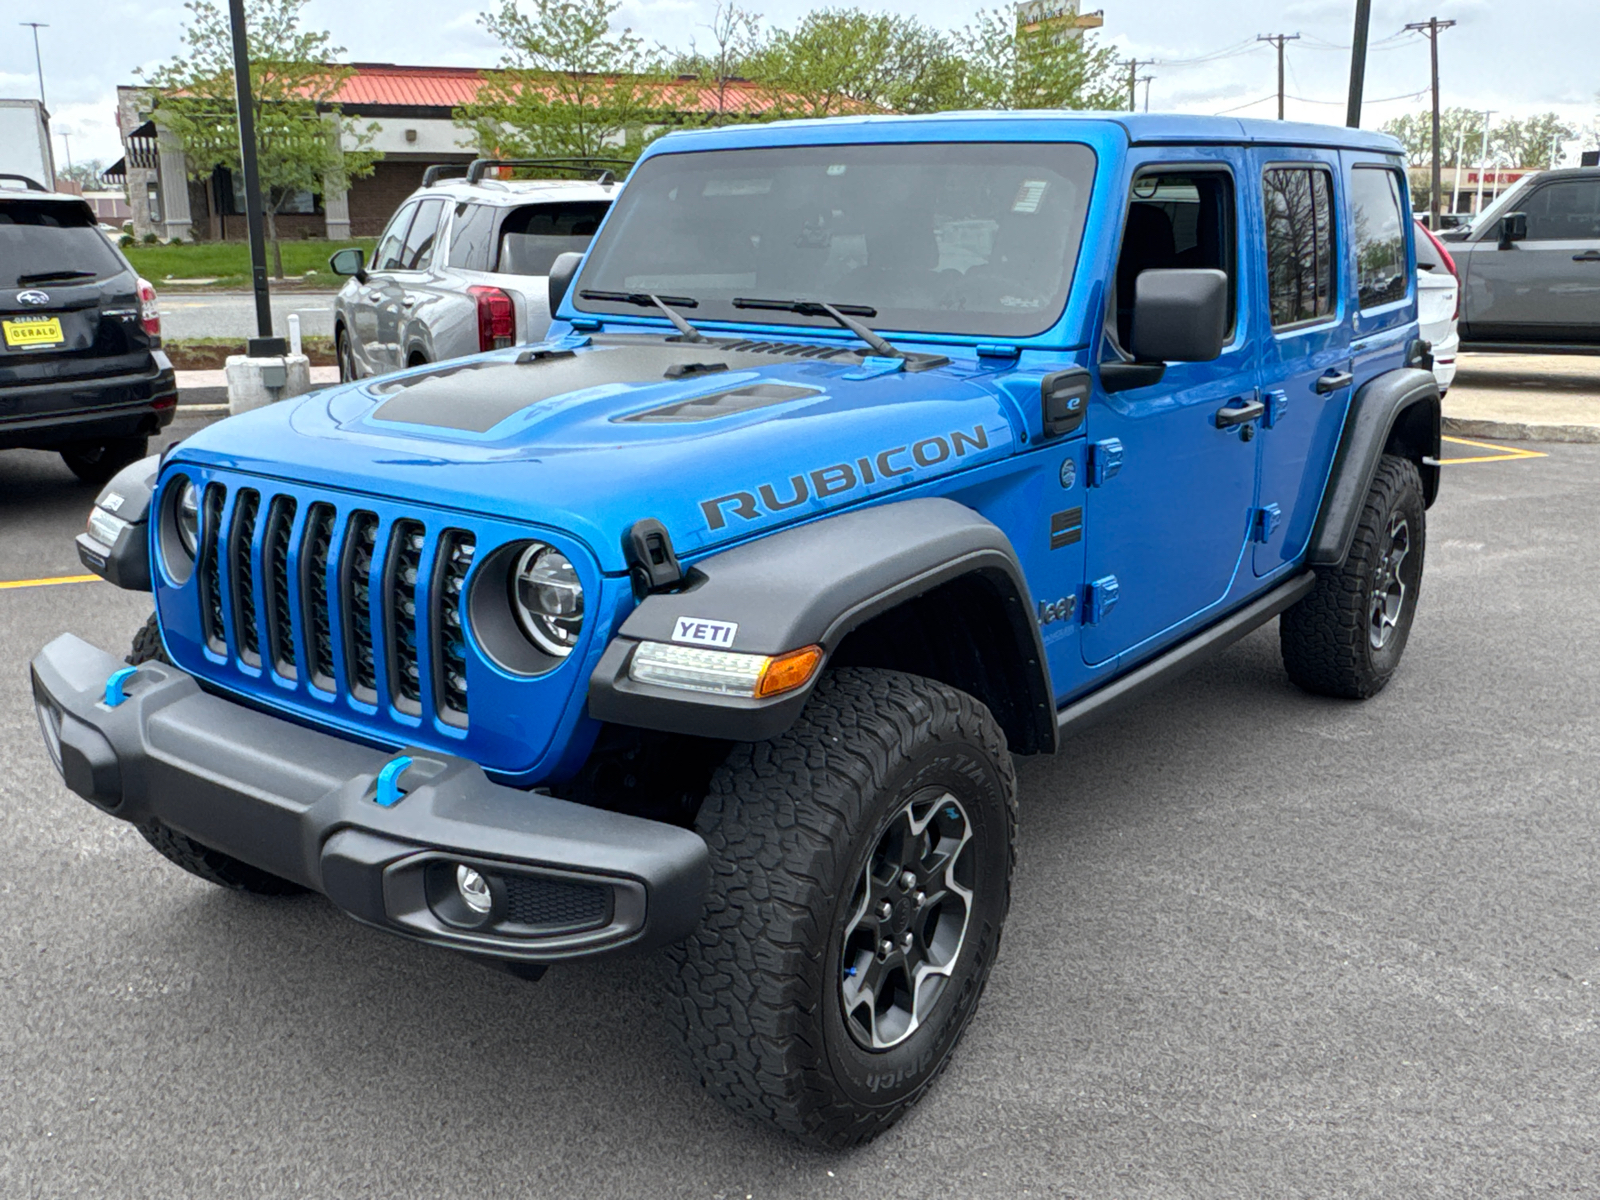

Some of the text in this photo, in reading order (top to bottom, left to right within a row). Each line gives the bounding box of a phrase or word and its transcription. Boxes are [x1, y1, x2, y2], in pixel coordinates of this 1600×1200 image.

[13, 328, 56, 338] GERALD
[699, 424, 990, 531] RUBICON
[680, 621, 731, 643] YETI
